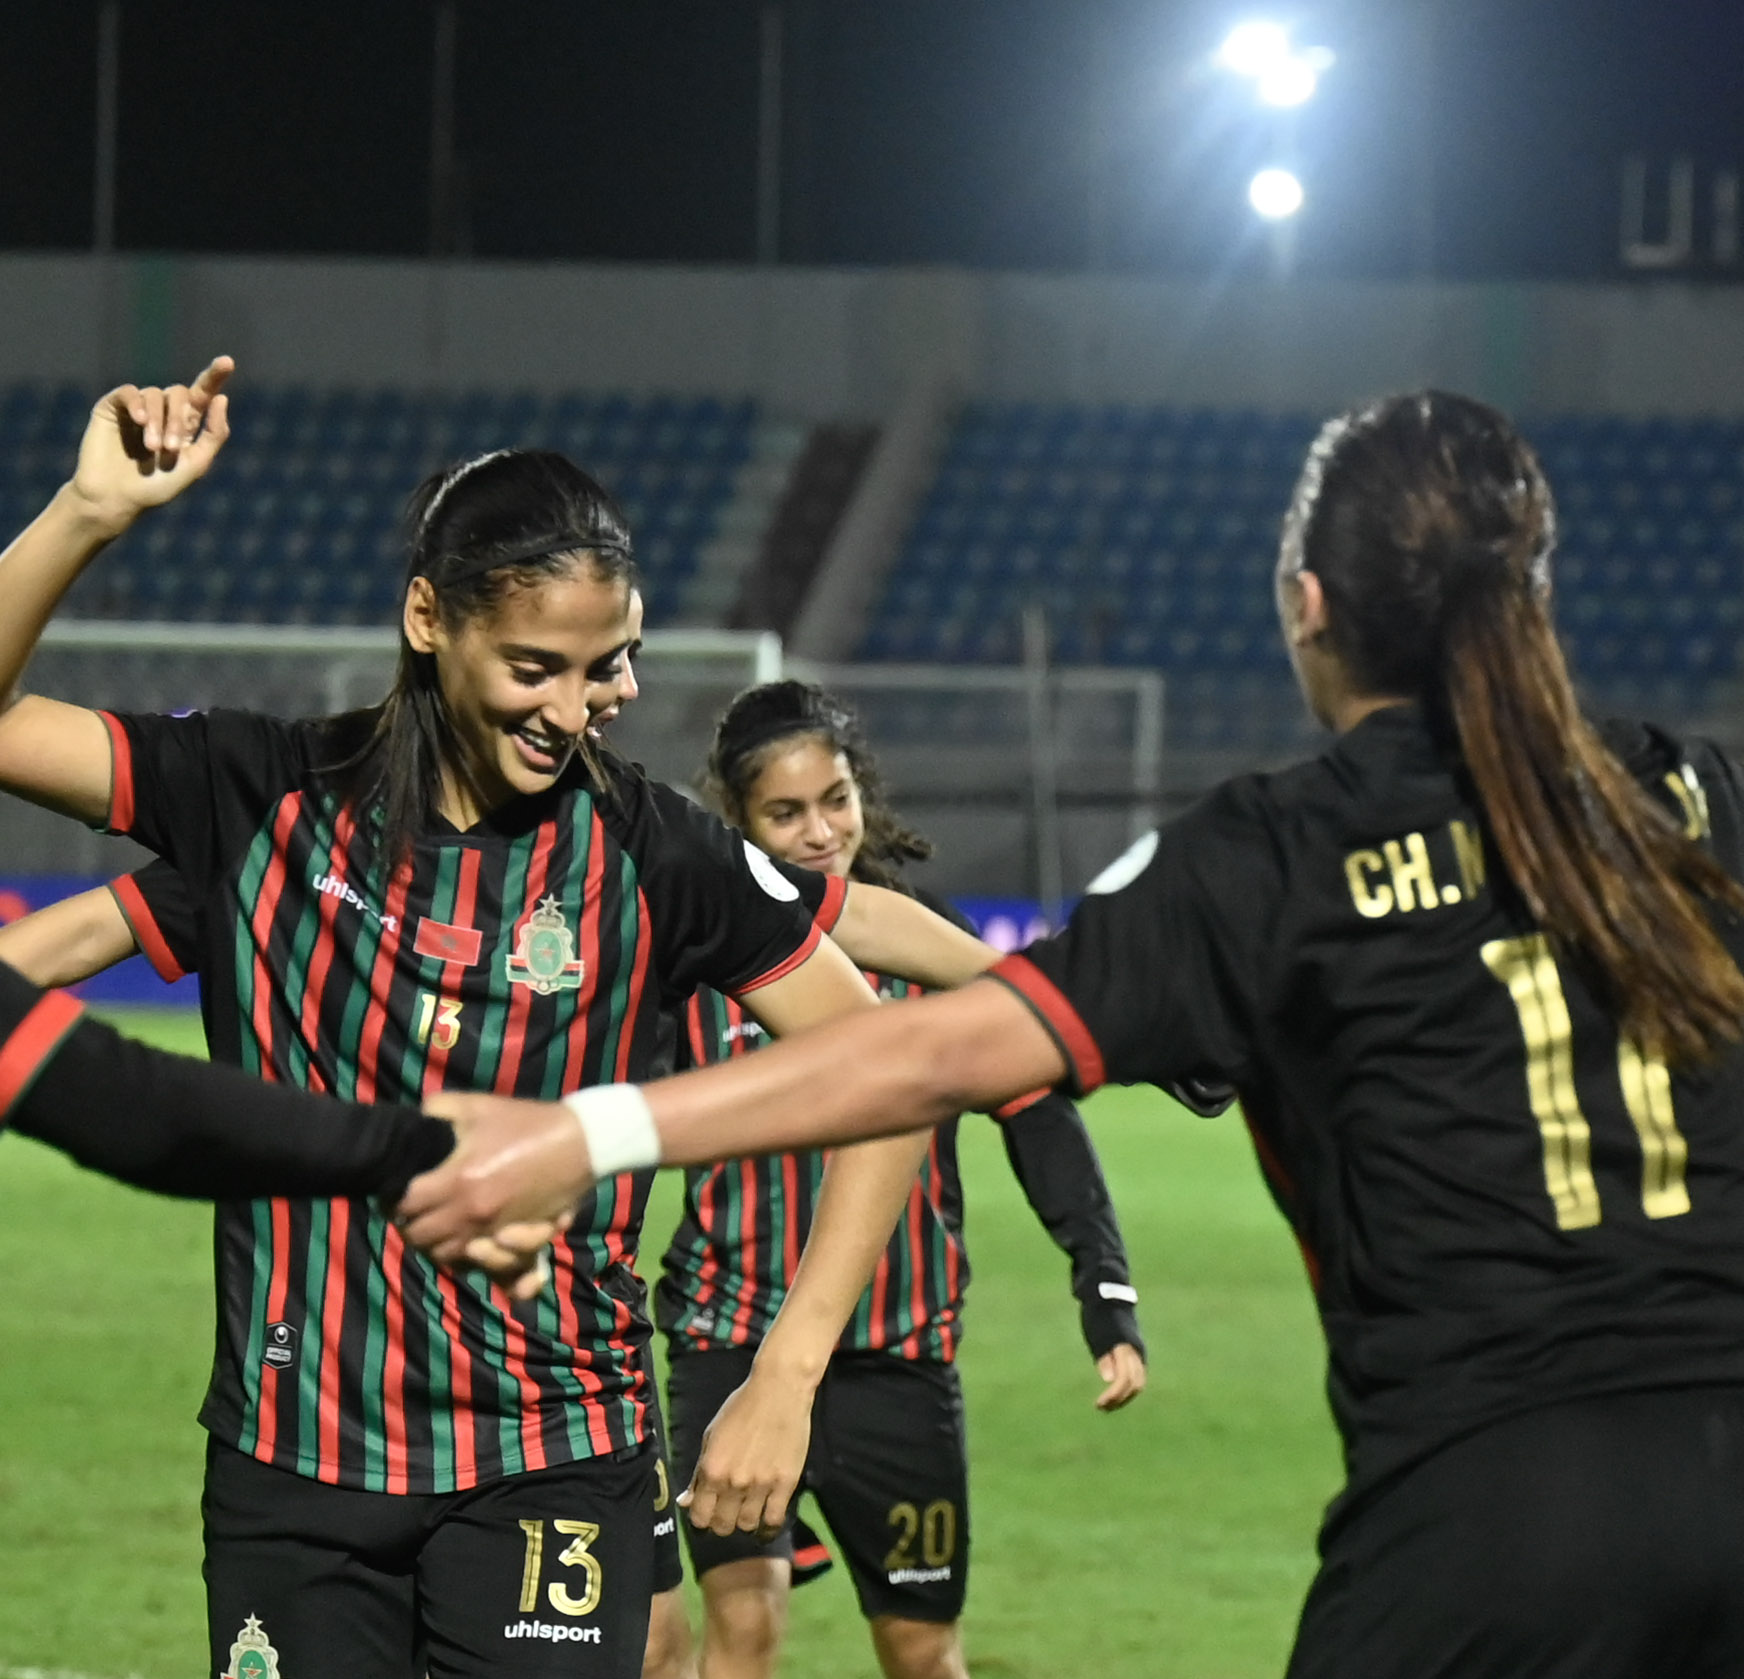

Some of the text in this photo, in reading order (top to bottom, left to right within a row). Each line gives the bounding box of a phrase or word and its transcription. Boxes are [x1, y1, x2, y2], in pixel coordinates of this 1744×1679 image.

[417, 993, 464, 1050] 13
[883, 1500, 956, 1571] 20
[519, 1519, 603, 1617] 13
[504, 1619, 602, 1645] uhlsport
